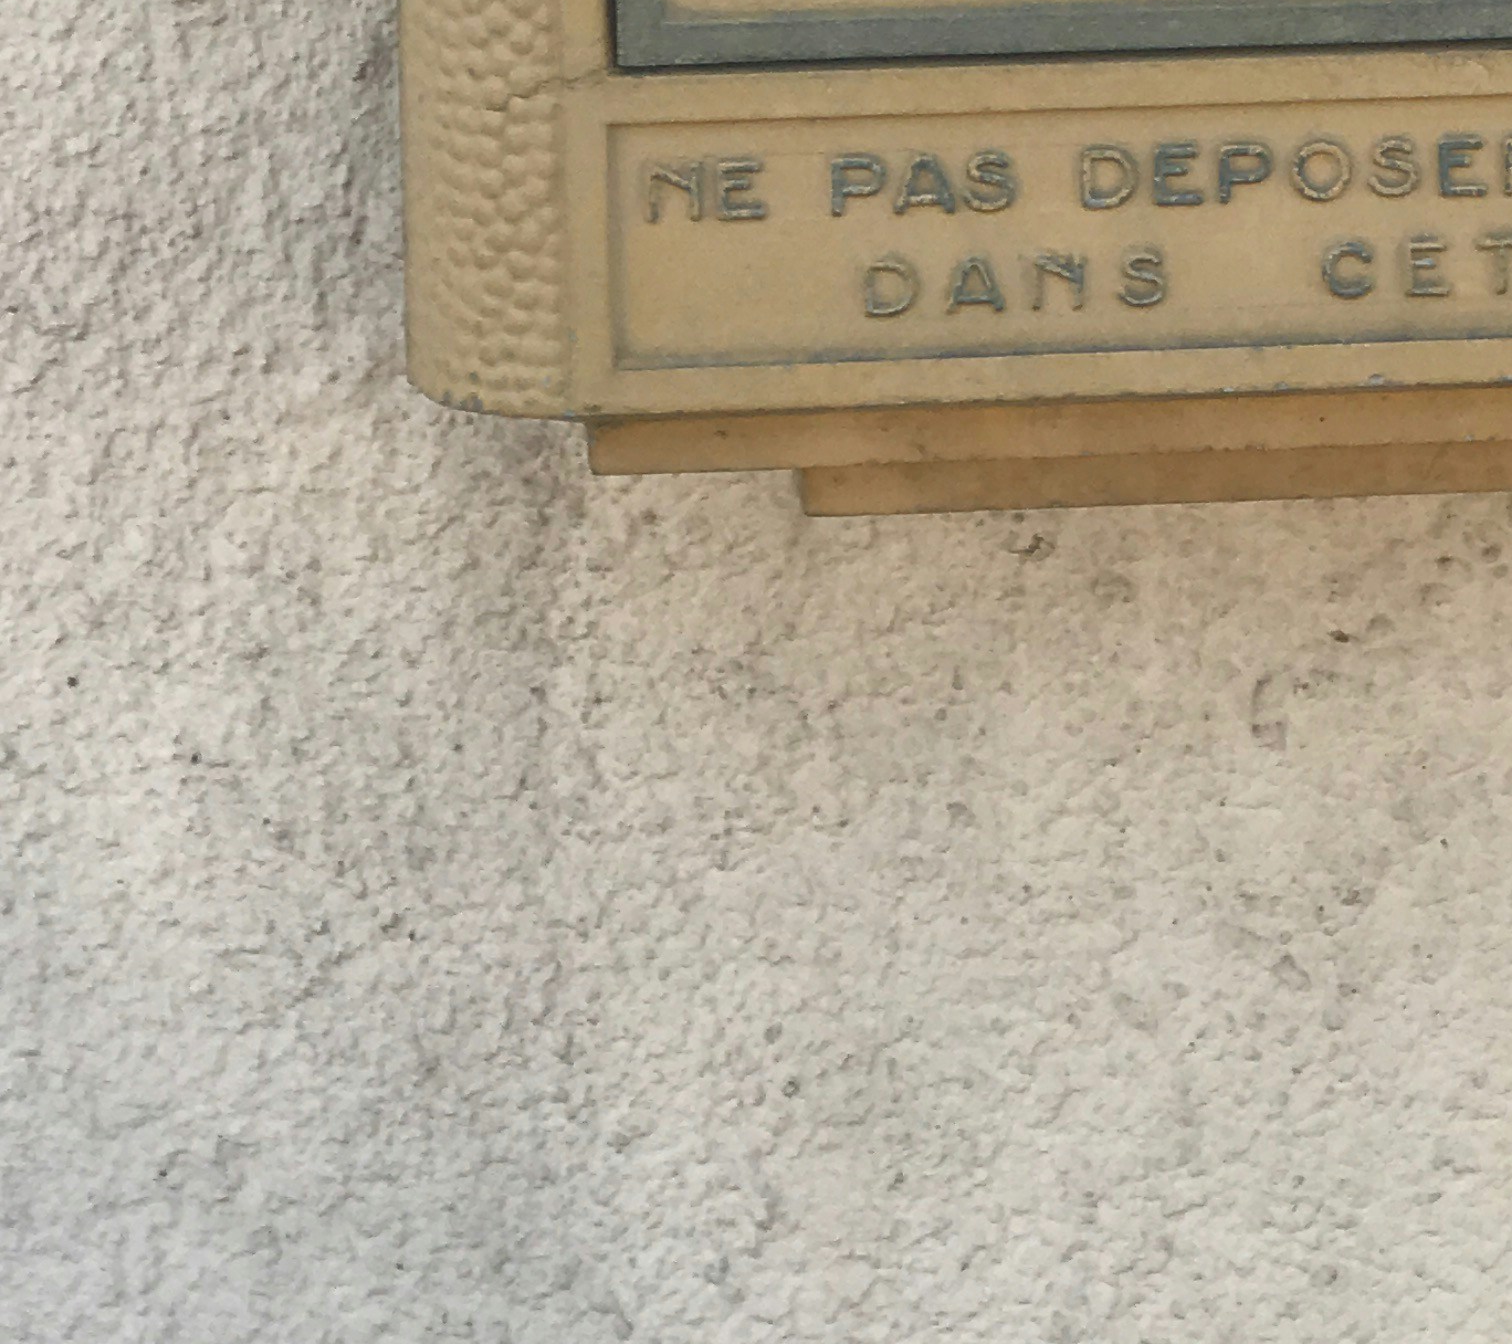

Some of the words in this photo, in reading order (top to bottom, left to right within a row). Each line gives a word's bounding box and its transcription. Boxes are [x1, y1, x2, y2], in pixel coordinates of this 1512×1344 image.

[645, 156, 770, 223] NE
[828, 150, 1019, 218] PAS
[862, 248, 1169, 319] DANS
